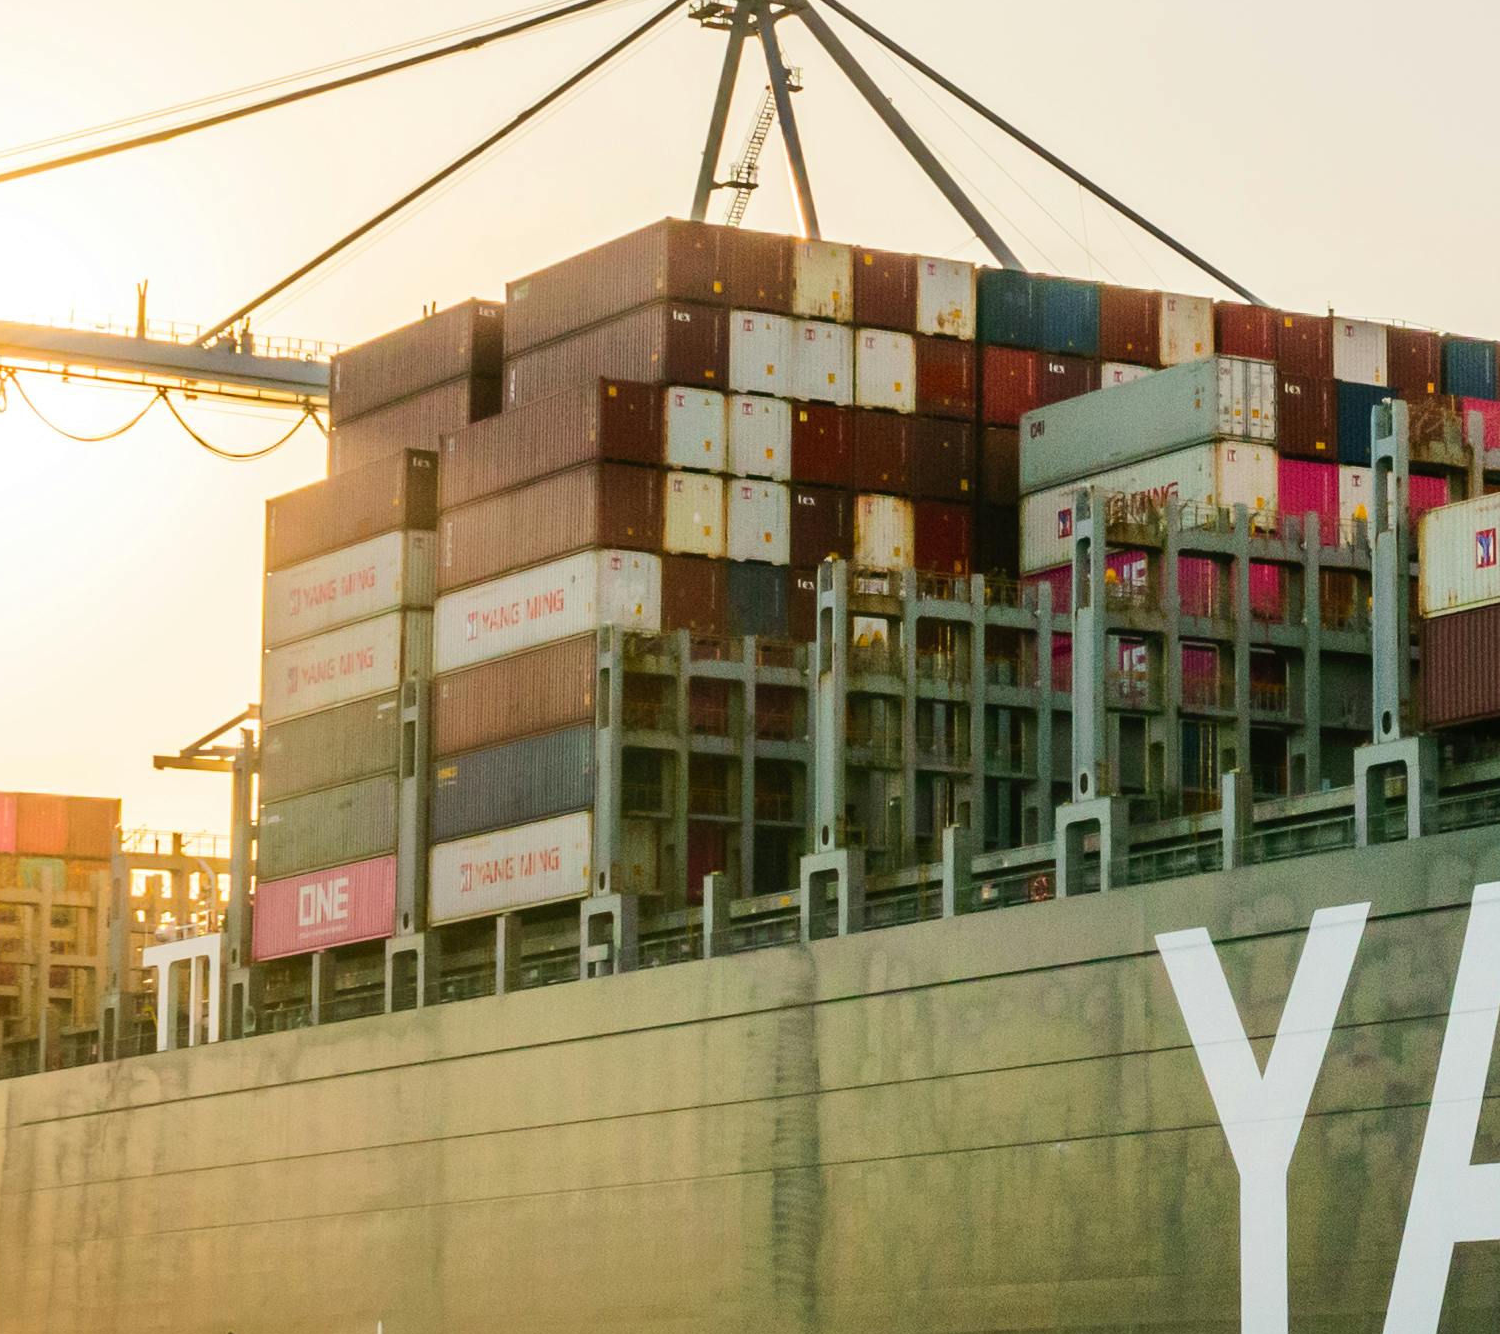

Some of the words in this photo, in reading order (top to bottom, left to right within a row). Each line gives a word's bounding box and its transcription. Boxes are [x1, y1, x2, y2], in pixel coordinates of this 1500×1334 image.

[673, 309, 691, 323] tex
[1049, 361, 1066, 374] tex
[1284, 382, 1301, 395] tex
[797, 493, 816, 507] tex
[482, 602, 519, 633] YANG
[526, 588, 565, 621] MING
[476, 857, 514, 884] YANG
[520, 846, 561, 877] MING
[297, 876, 350, 928] ONE
